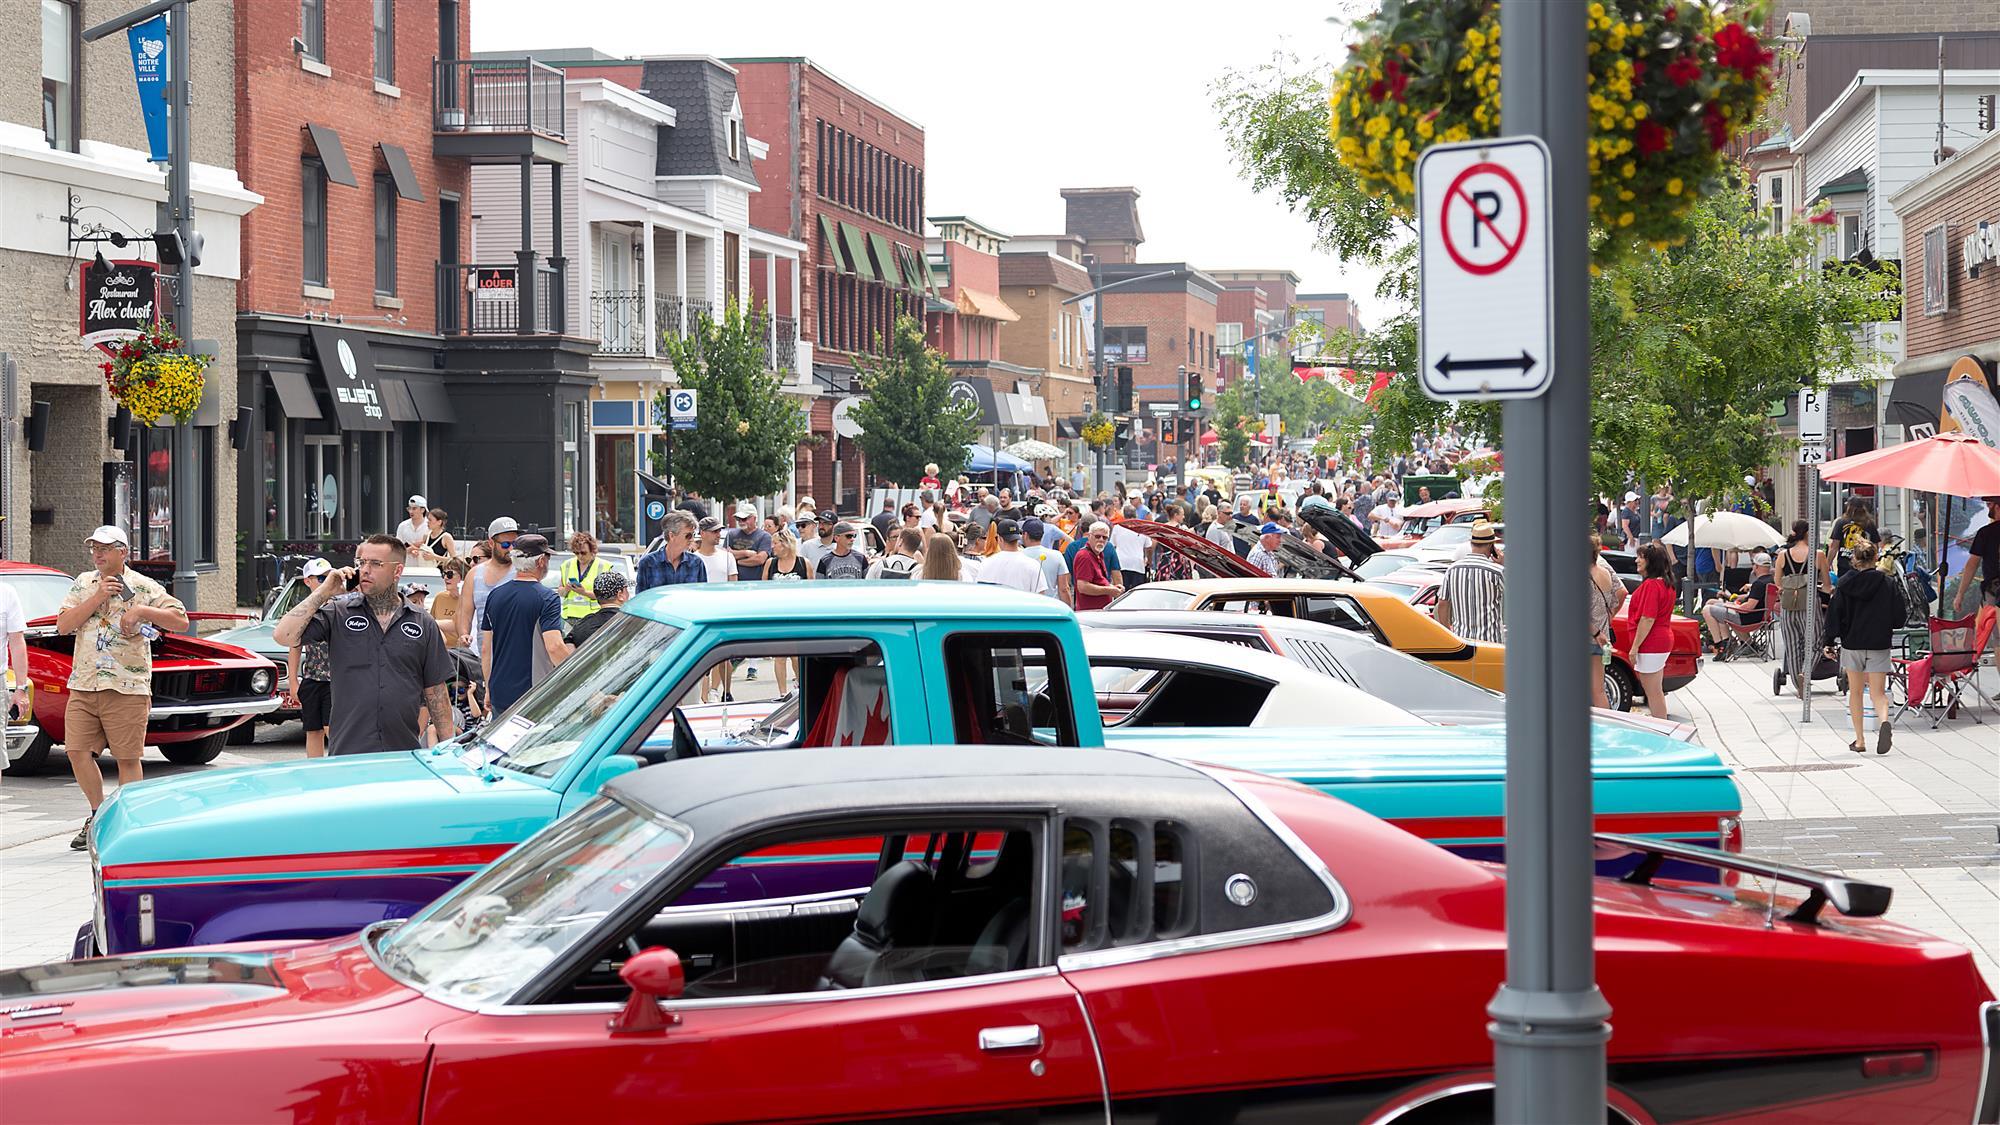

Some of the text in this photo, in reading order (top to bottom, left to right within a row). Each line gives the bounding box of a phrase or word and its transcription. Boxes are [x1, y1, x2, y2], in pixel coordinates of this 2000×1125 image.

[480, 279, 513, 288] LOUER
[100, 286, 139, 299] Restaurant
[336, 379, 378, 405] sushi
[363, 405, 383, 421] shop
